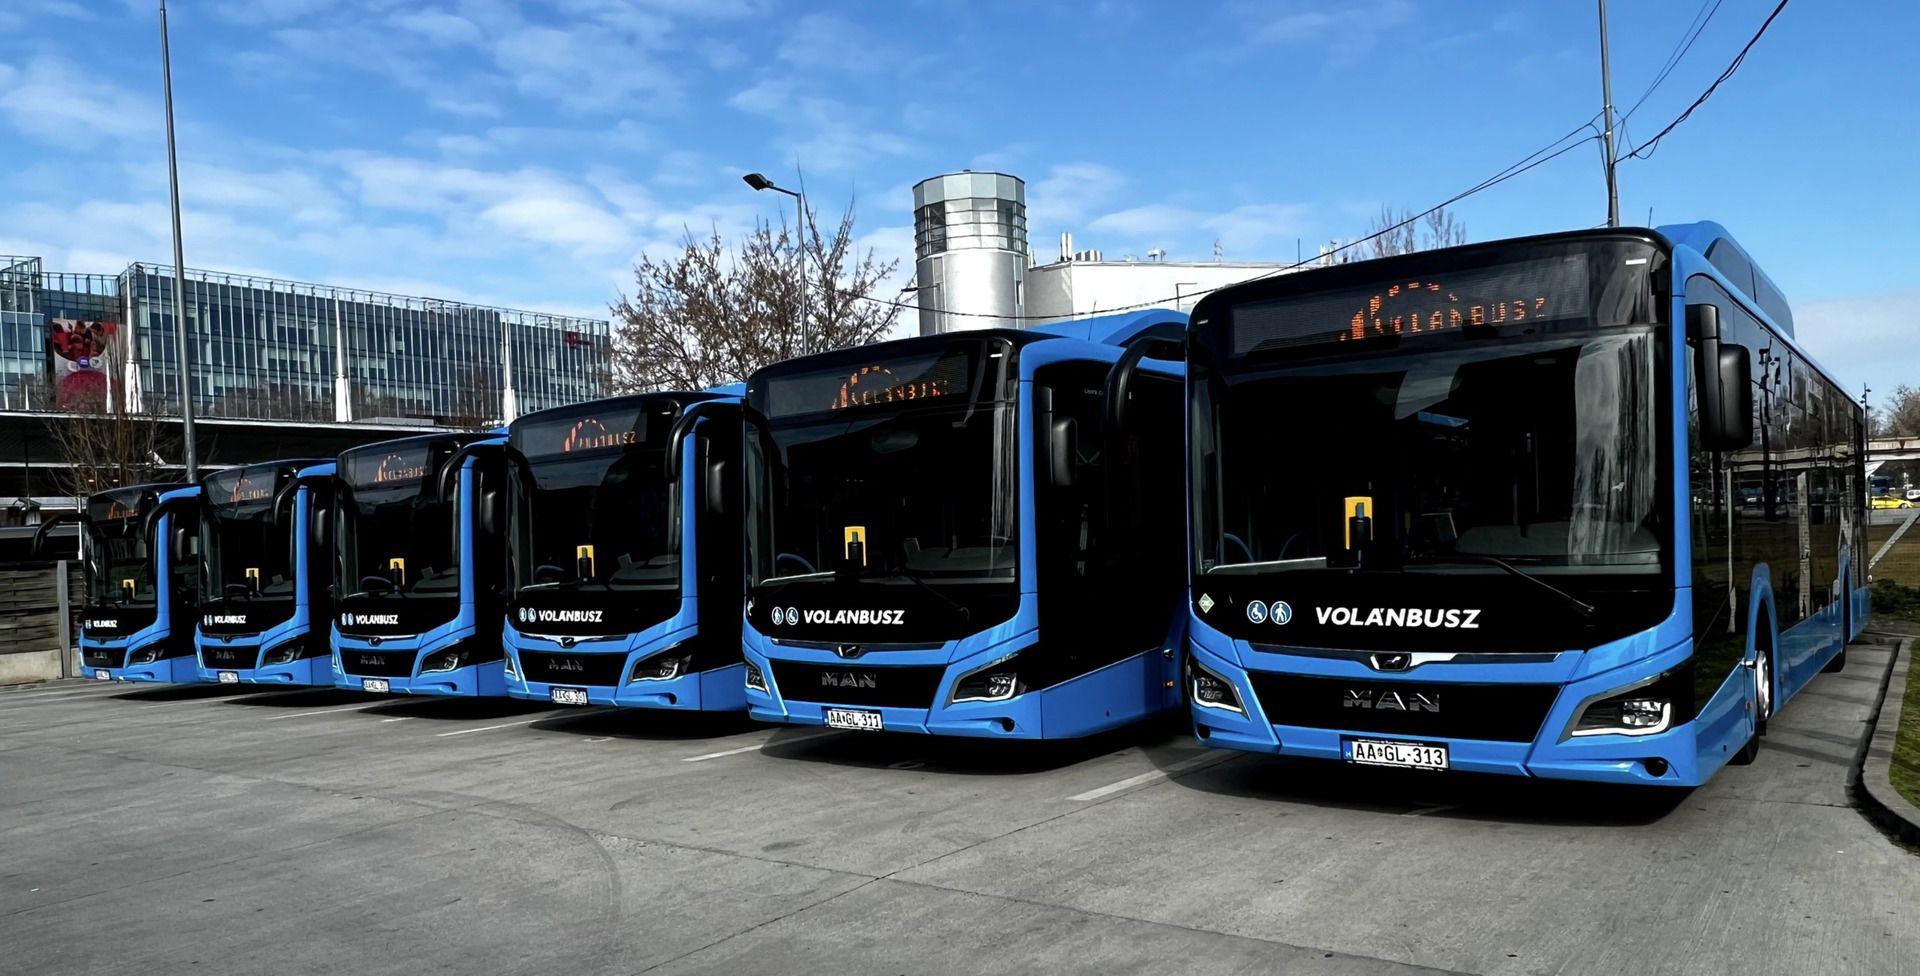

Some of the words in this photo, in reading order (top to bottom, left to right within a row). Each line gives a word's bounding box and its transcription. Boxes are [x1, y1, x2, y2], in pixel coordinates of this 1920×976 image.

[803, 609, 905, 625] VOLÁNBUSZ
[1315, 606, 1482, 629] VOLÁNBUSZ
[821, 671, 877, 689] MAN
[1343, 689, 1440, 713] MAN
